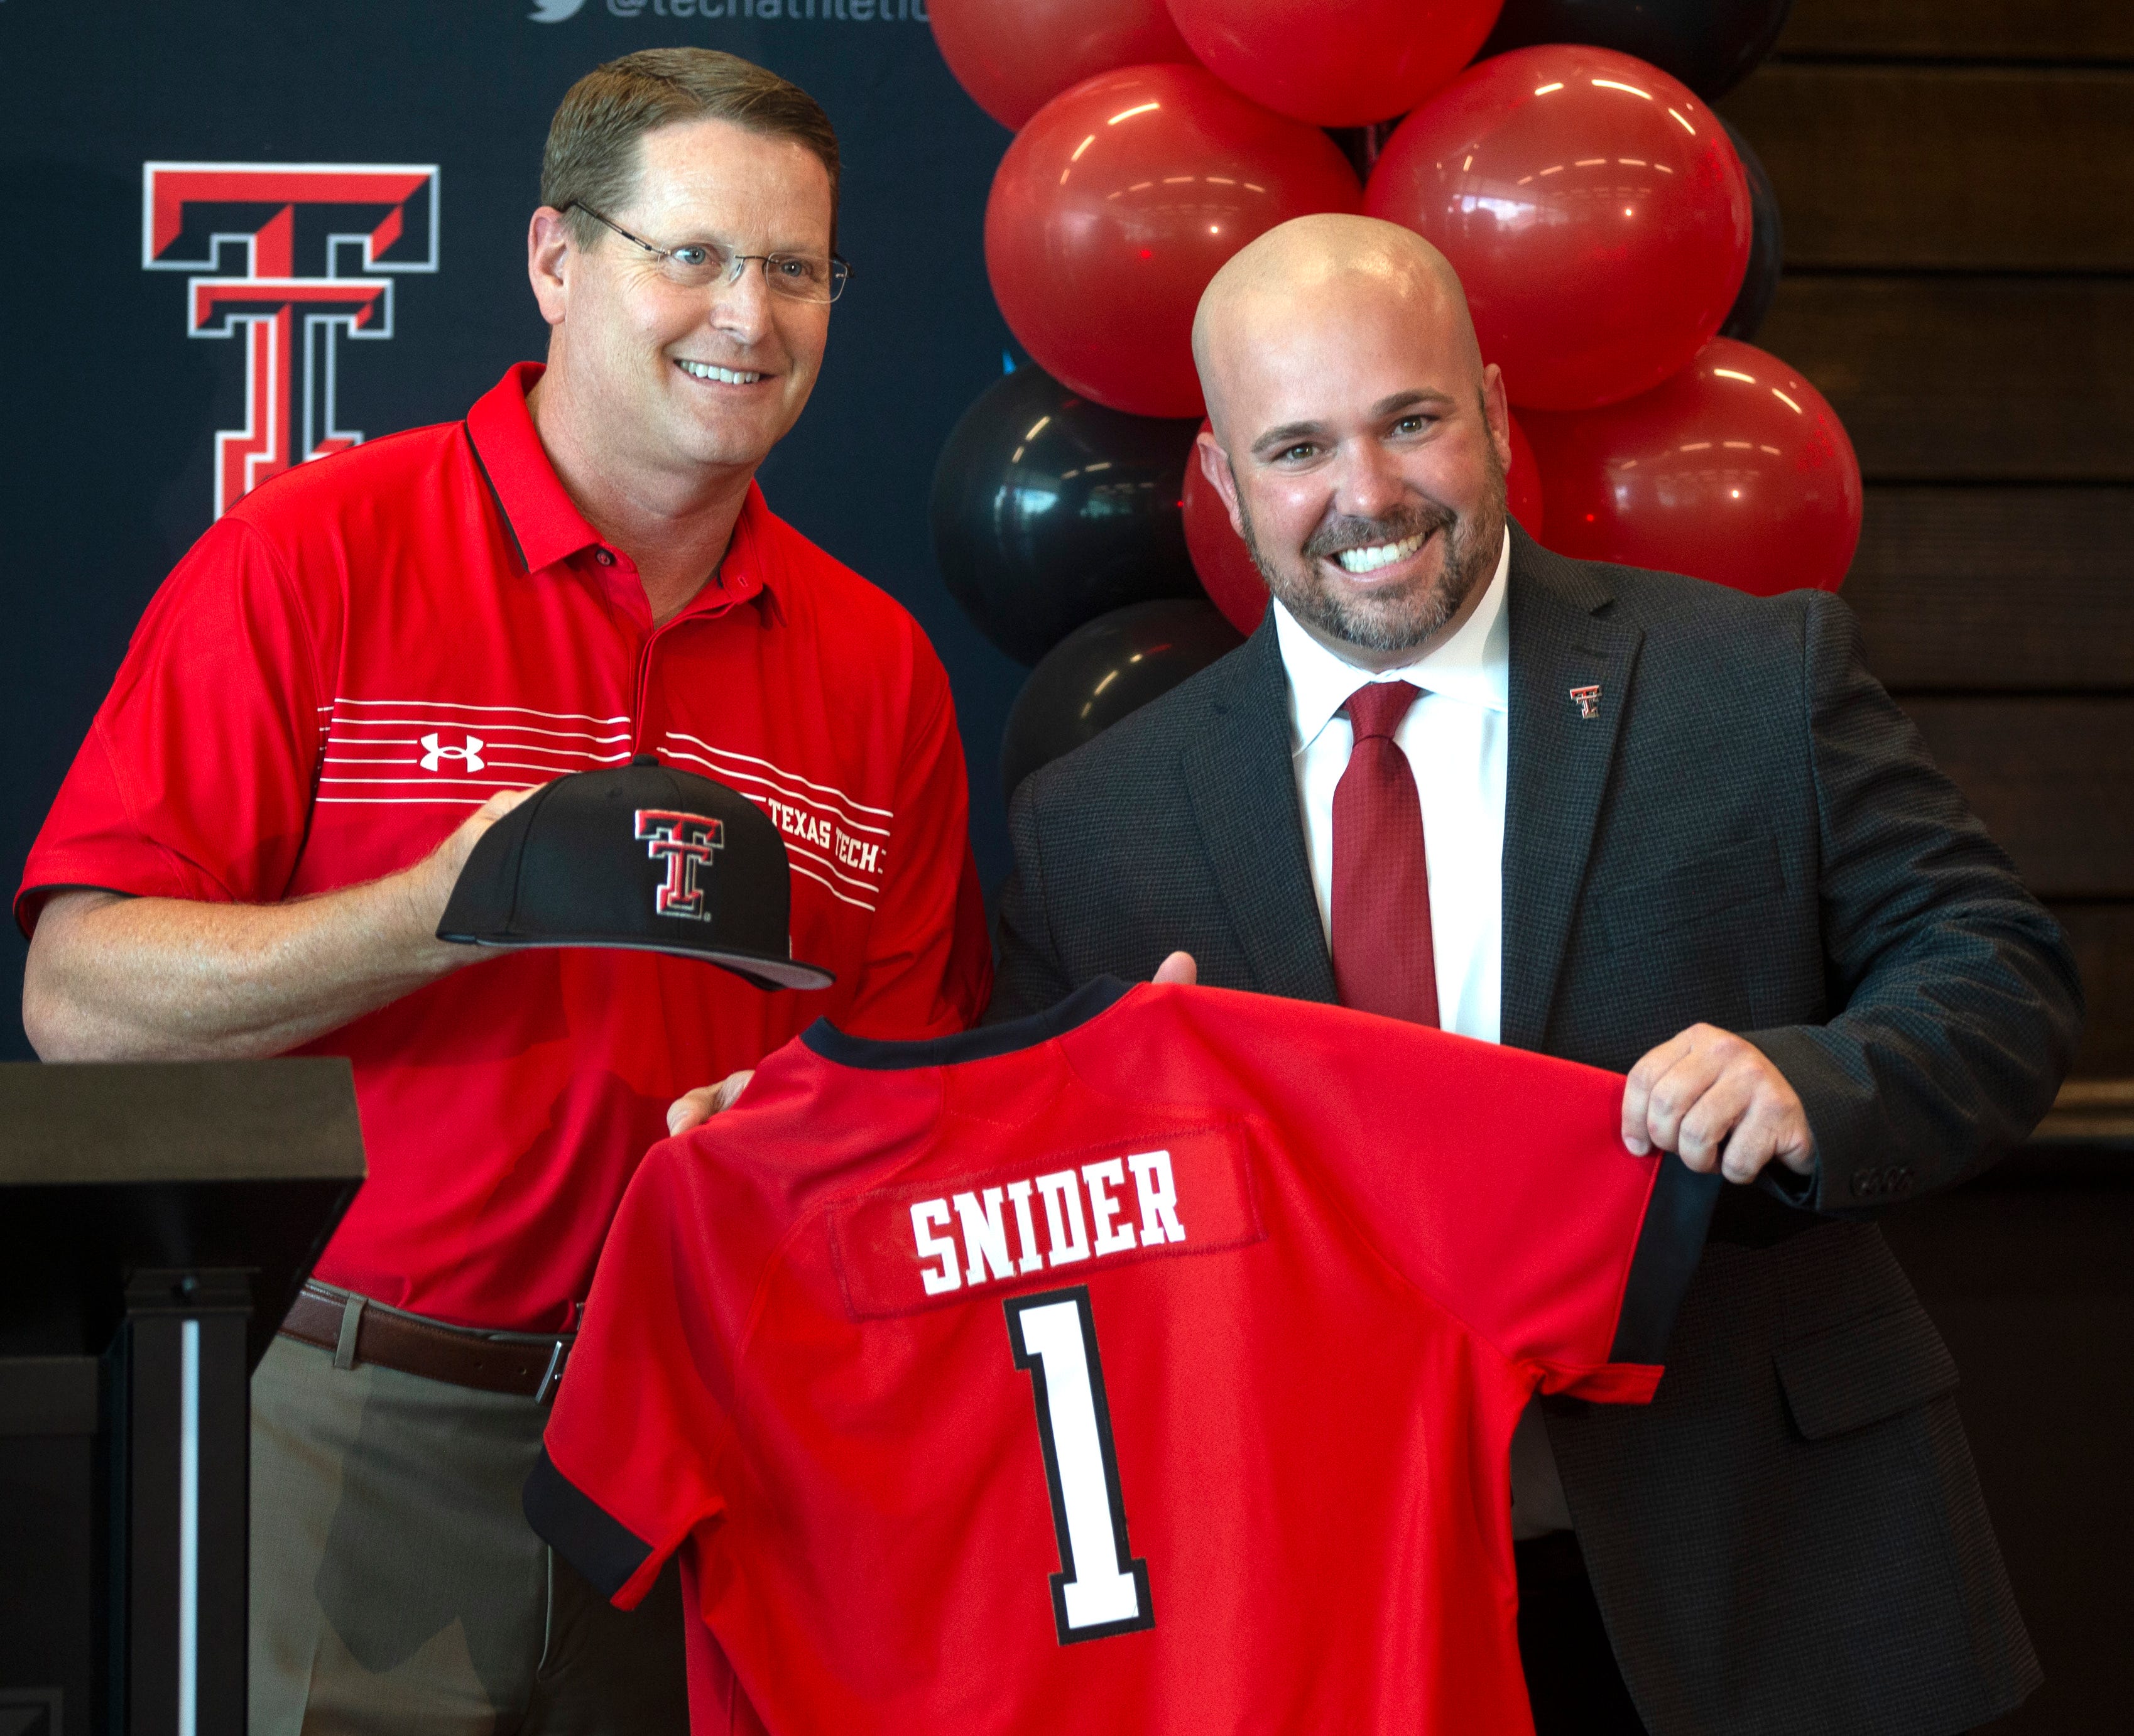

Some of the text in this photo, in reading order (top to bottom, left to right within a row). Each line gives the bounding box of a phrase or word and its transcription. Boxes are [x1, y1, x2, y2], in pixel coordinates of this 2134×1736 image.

[768, 797, 879, 873] TEXAS TECH
[910, 1150, 1186, 1296] SNIDER
[1002, 1284, 1156, 1646] 1
